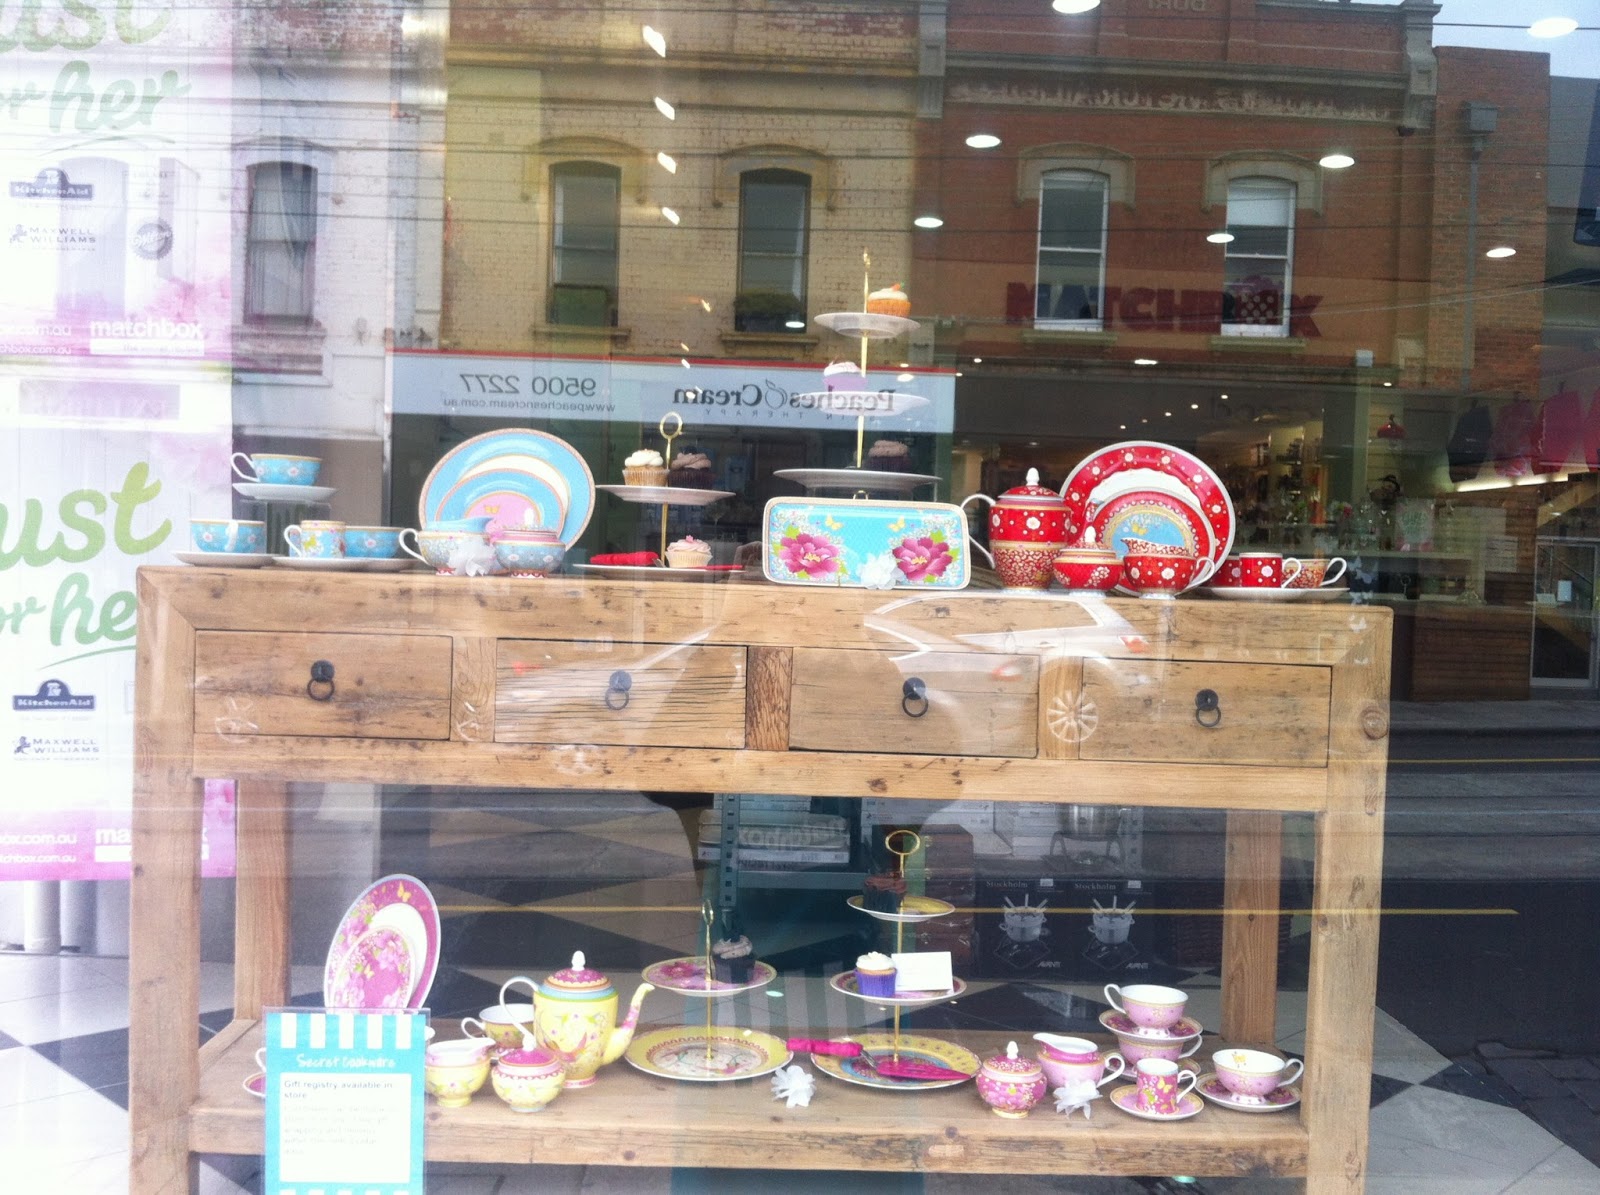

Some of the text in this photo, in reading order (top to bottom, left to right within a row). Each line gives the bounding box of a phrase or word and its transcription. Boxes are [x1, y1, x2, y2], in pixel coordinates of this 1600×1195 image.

[50, 60, 192, 133] her
[14, 185, 90, 195] KitchenAid
[30, 227, 94, 235] MAXWELL
[31, 236, 97, 244] WILLIAMS
[89, 318, 204, 340] matchbox
[17, 698, 92, 706] KitchenAid
[986, 881, 1028, 889] Stockholm
[1074, 883, 1117, 891] Stockholm
[284, 1080, 394, 1090] Gift registry available in
